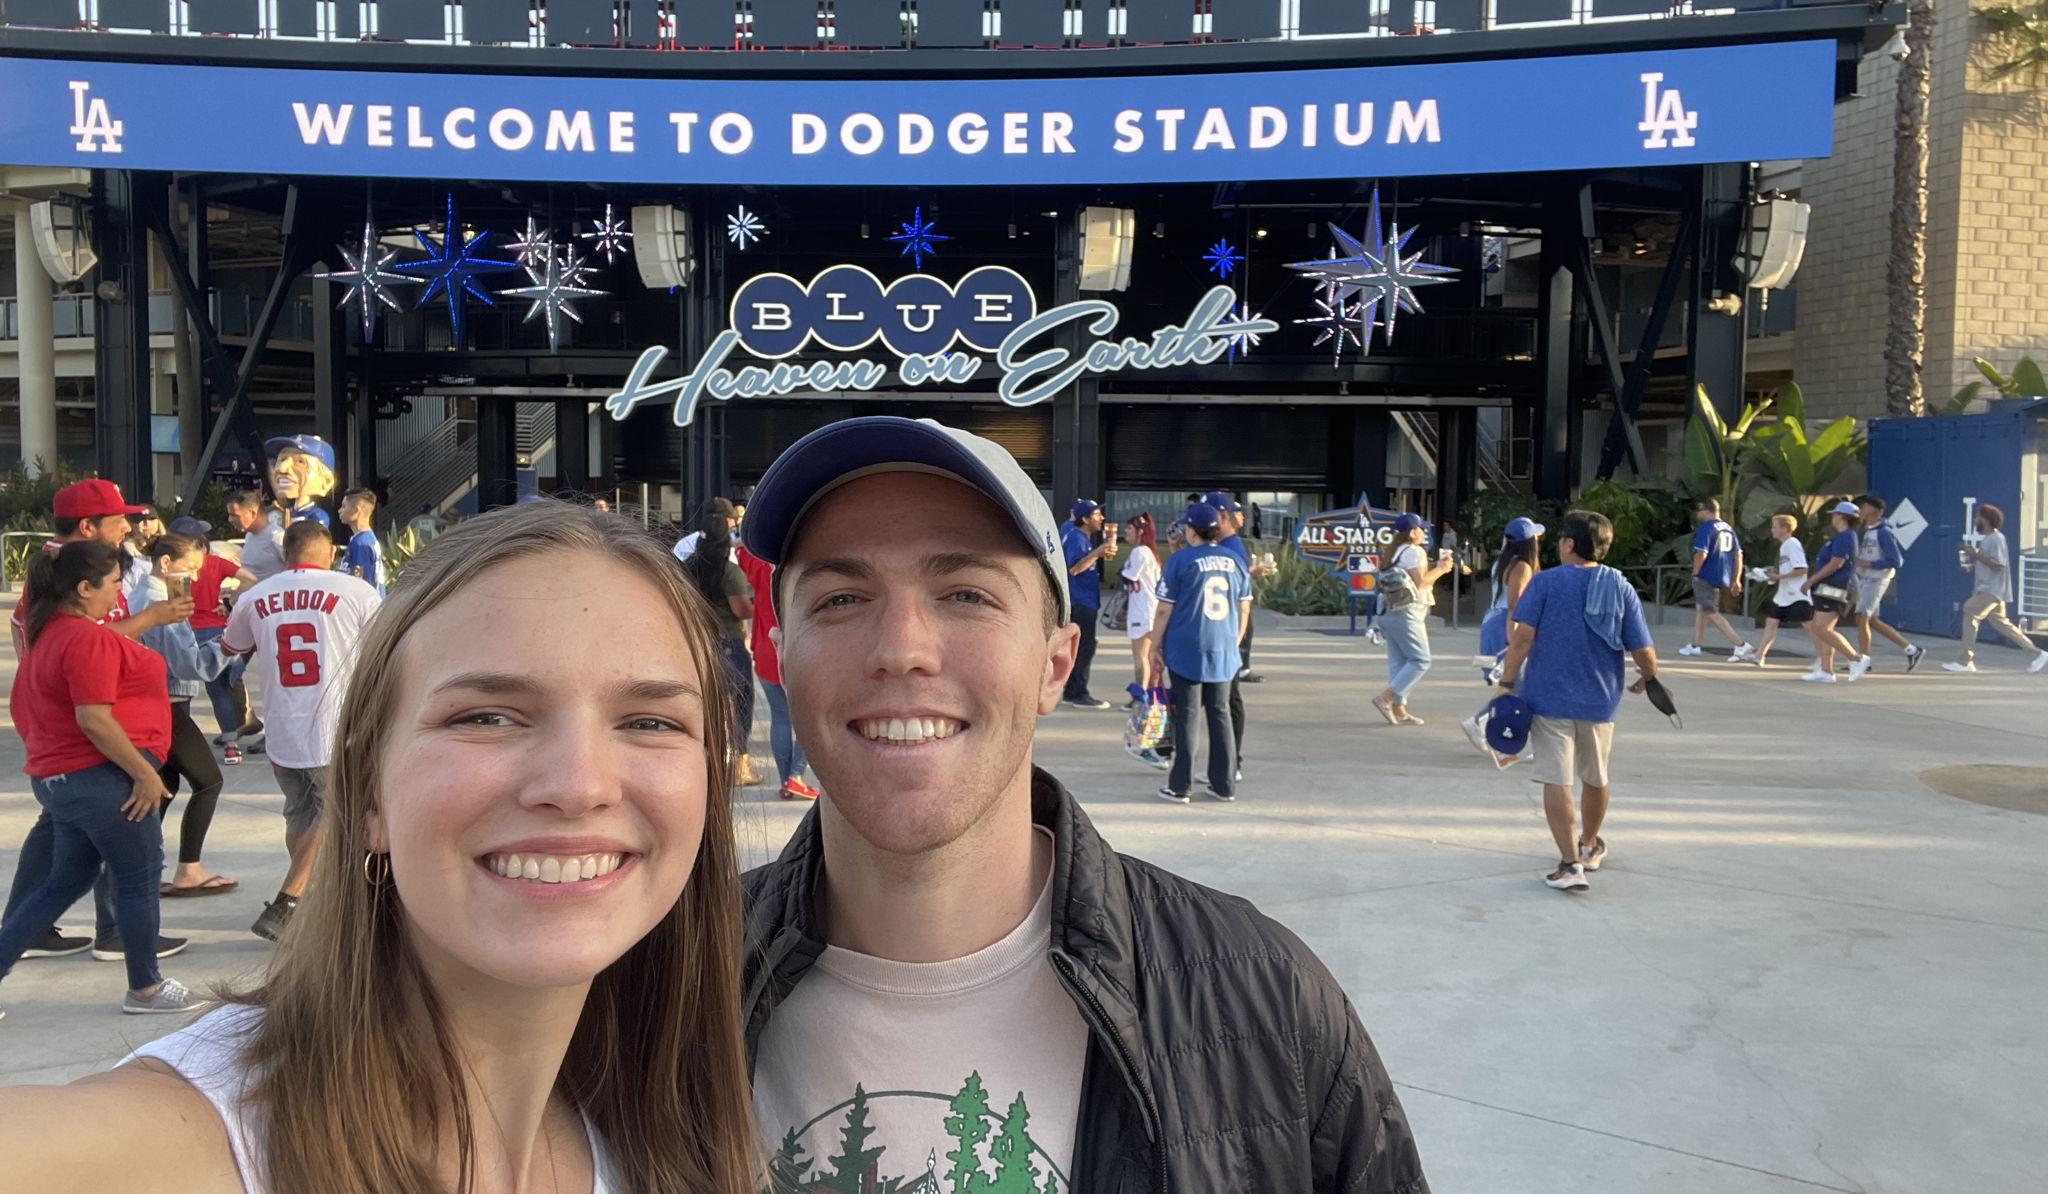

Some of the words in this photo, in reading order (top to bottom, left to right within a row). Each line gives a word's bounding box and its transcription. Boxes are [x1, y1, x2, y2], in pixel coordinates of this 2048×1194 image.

[69, 81, 123, 153] LA
[292, 102, 635, 153] WELCOME
[669, 112, 754, 155] TO
[791, 112, 1076, 155] DODGER
[1113, 99, 1441, 153] STADIUM
[1638, 72, 1698, 149] LA
[752, 292, 1013, 333] BLUE
[605, 330, 887, 427] Heaven
[899, 351, 982, 386] on
[997, 284, 1280, 407] Earth
[1297, 526, 1328, 544] ALL
[1333, 526, 1375, 544] STAR
[1350, 545, 1377, 554] 2022
[1194, 555, 1236, 573] TURNER
[254, 589, 340, 619] RENDON
[1203, 575, 1230, 621] 6
[276, 622, 321, 688] 6
